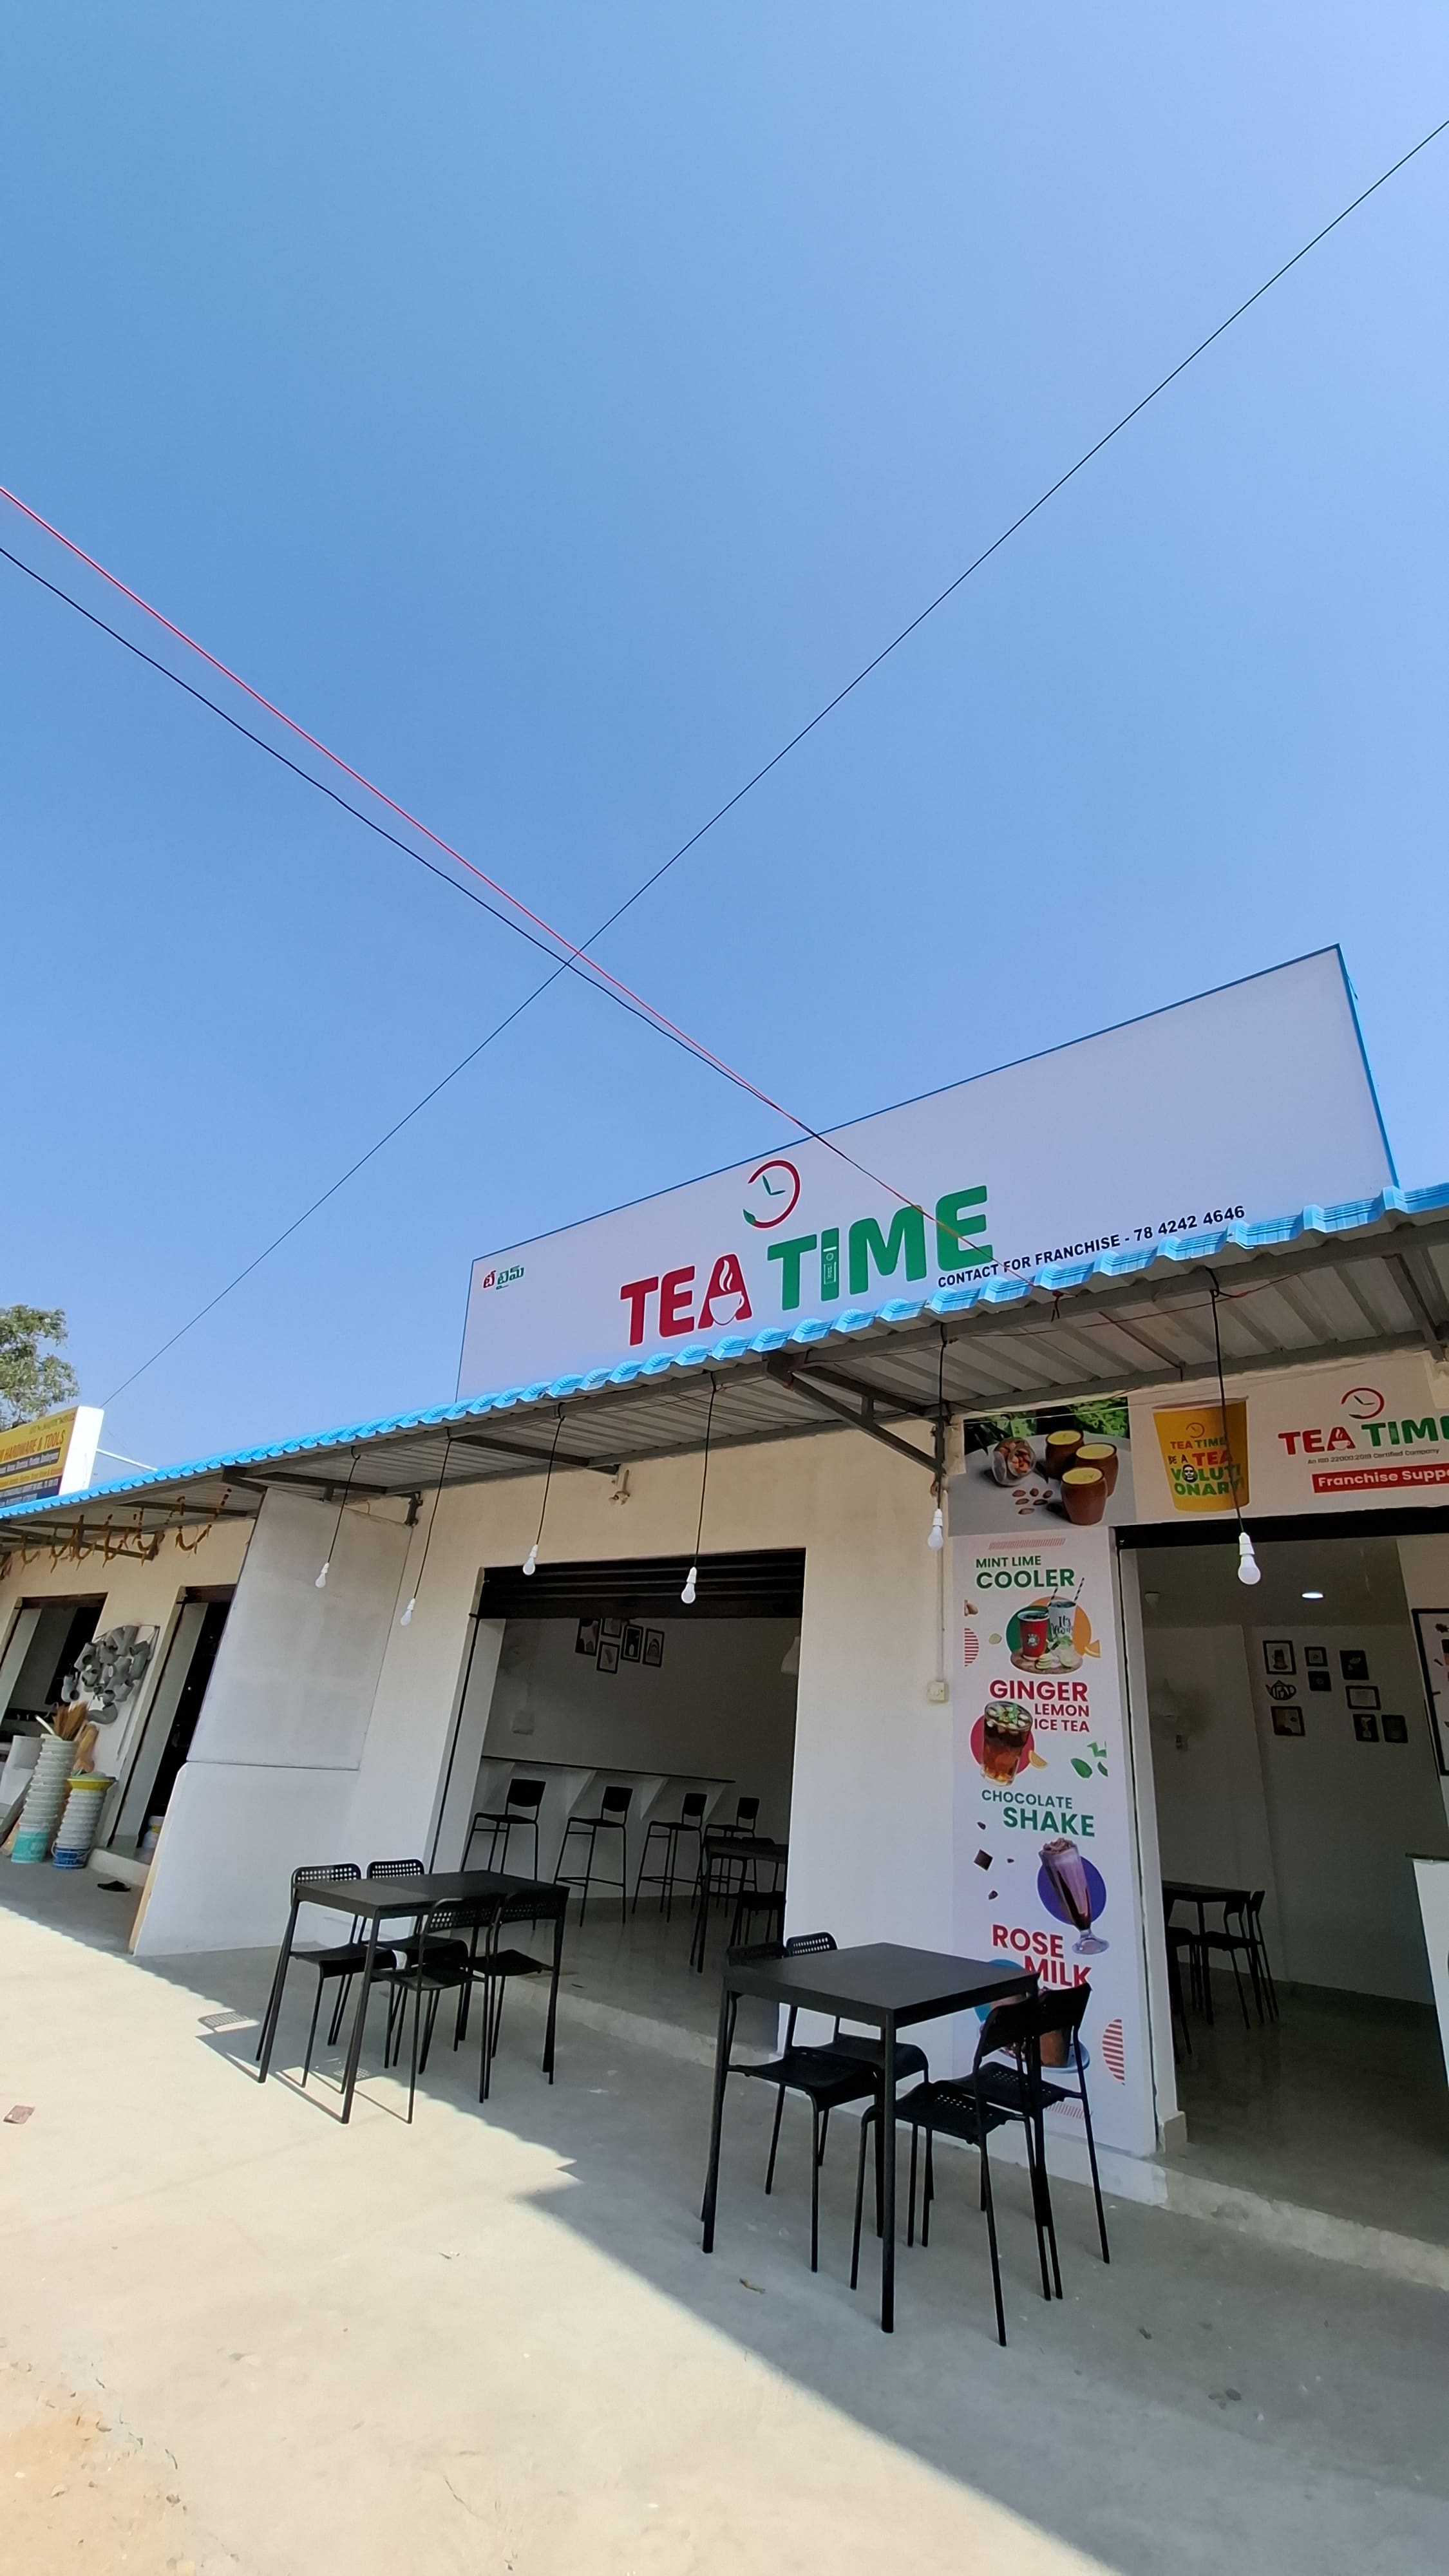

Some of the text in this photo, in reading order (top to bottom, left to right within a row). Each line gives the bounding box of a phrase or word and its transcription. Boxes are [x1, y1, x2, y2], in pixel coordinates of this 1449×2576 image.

[938, 1264, 999, 1288] CONTACT
[1003, 1257, 1031, 1273] FOR
[1035, 1235, 1121, 1265] FRANCHISE
[1133, 1226, 1153, 1242] 78
[1158, 1215, 1197, 1235] 4242
[1203, 1206, 1245, 1224] 4646
[620, 1185, 993, 1346] TEA TIME
[44, 1429, 66, 1449] TOOLS
[1170, 1441, 1193, 1450] TEA
[1278, 1426, 1356, 1455] TEA
[1181, 1454, 1188, 1463] A
[1192, 1450, 1233, 1466] TEA
[1373, 1450, 1403, 1459] Certified
[1318, 1469, 1449, 1487] Franchise Supp
[976, 1556, 1041, 1568] MINT LIME
[976, 1569, 1075, 1589] COOLER
[989, 1680, 1088, 1702] GINGER
[1034, 1703, 1090, 1717] LEMON
[1034, 1719, 1090, 1732] ICE TEA
[981, 1790, 1072, 1809] CHOCOLATE
[1003, 1807, 1095, 1837] SHAKE
[992, 1924, 1064, 1958] ROSE
[1024, 1955, 1092, 1988] MILK
